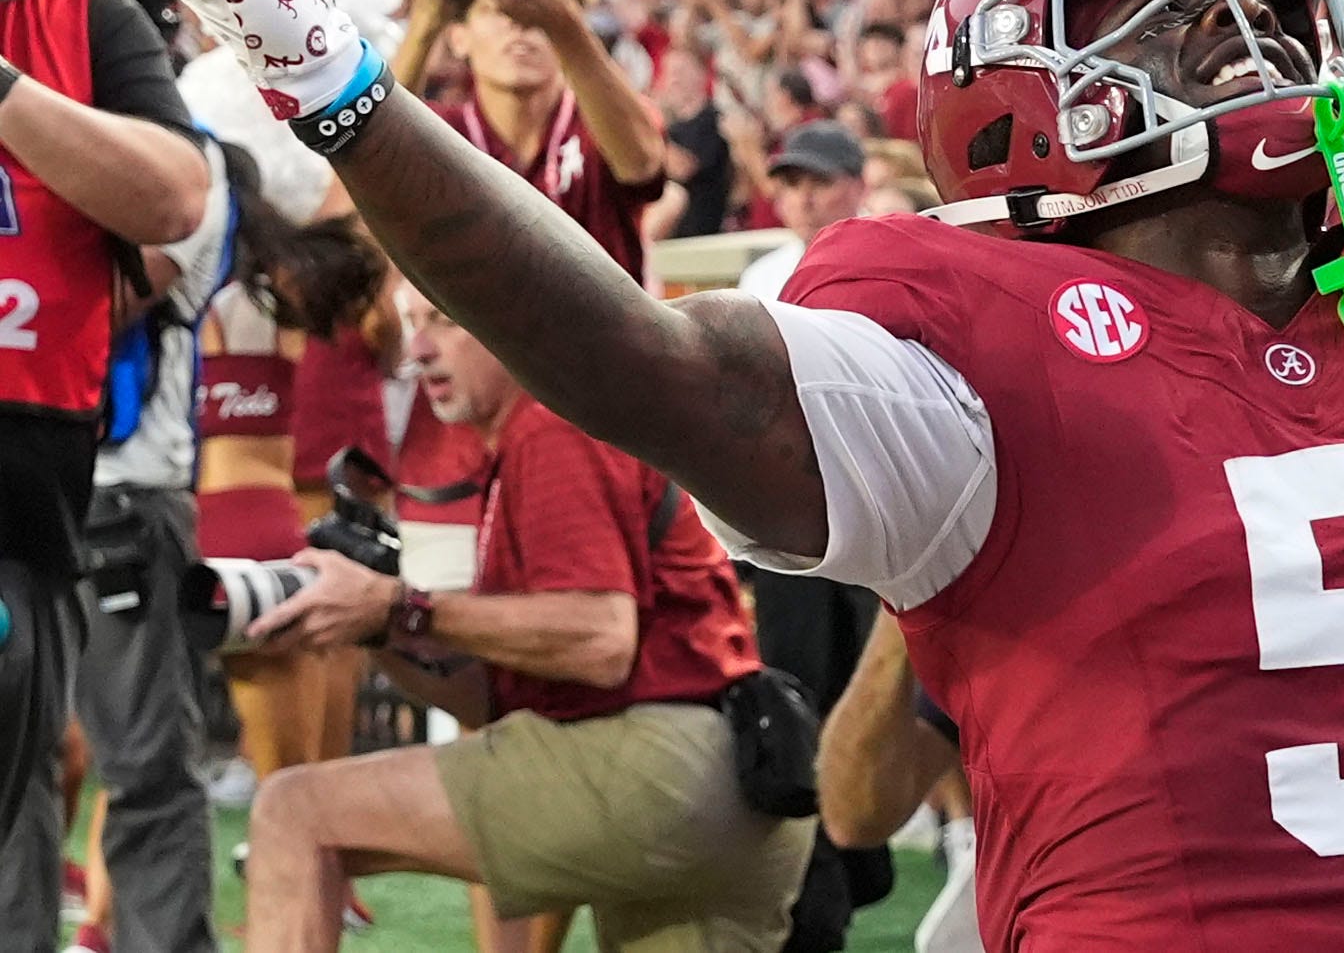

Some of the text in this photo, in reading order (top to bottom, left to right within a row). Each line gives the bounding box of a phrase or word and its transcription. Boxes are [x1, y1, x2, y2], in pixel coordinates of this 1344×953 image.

[1039, 180, 1149, 216] CRIMSON TIDE
[1057, 283, 1142, 357] SEC
